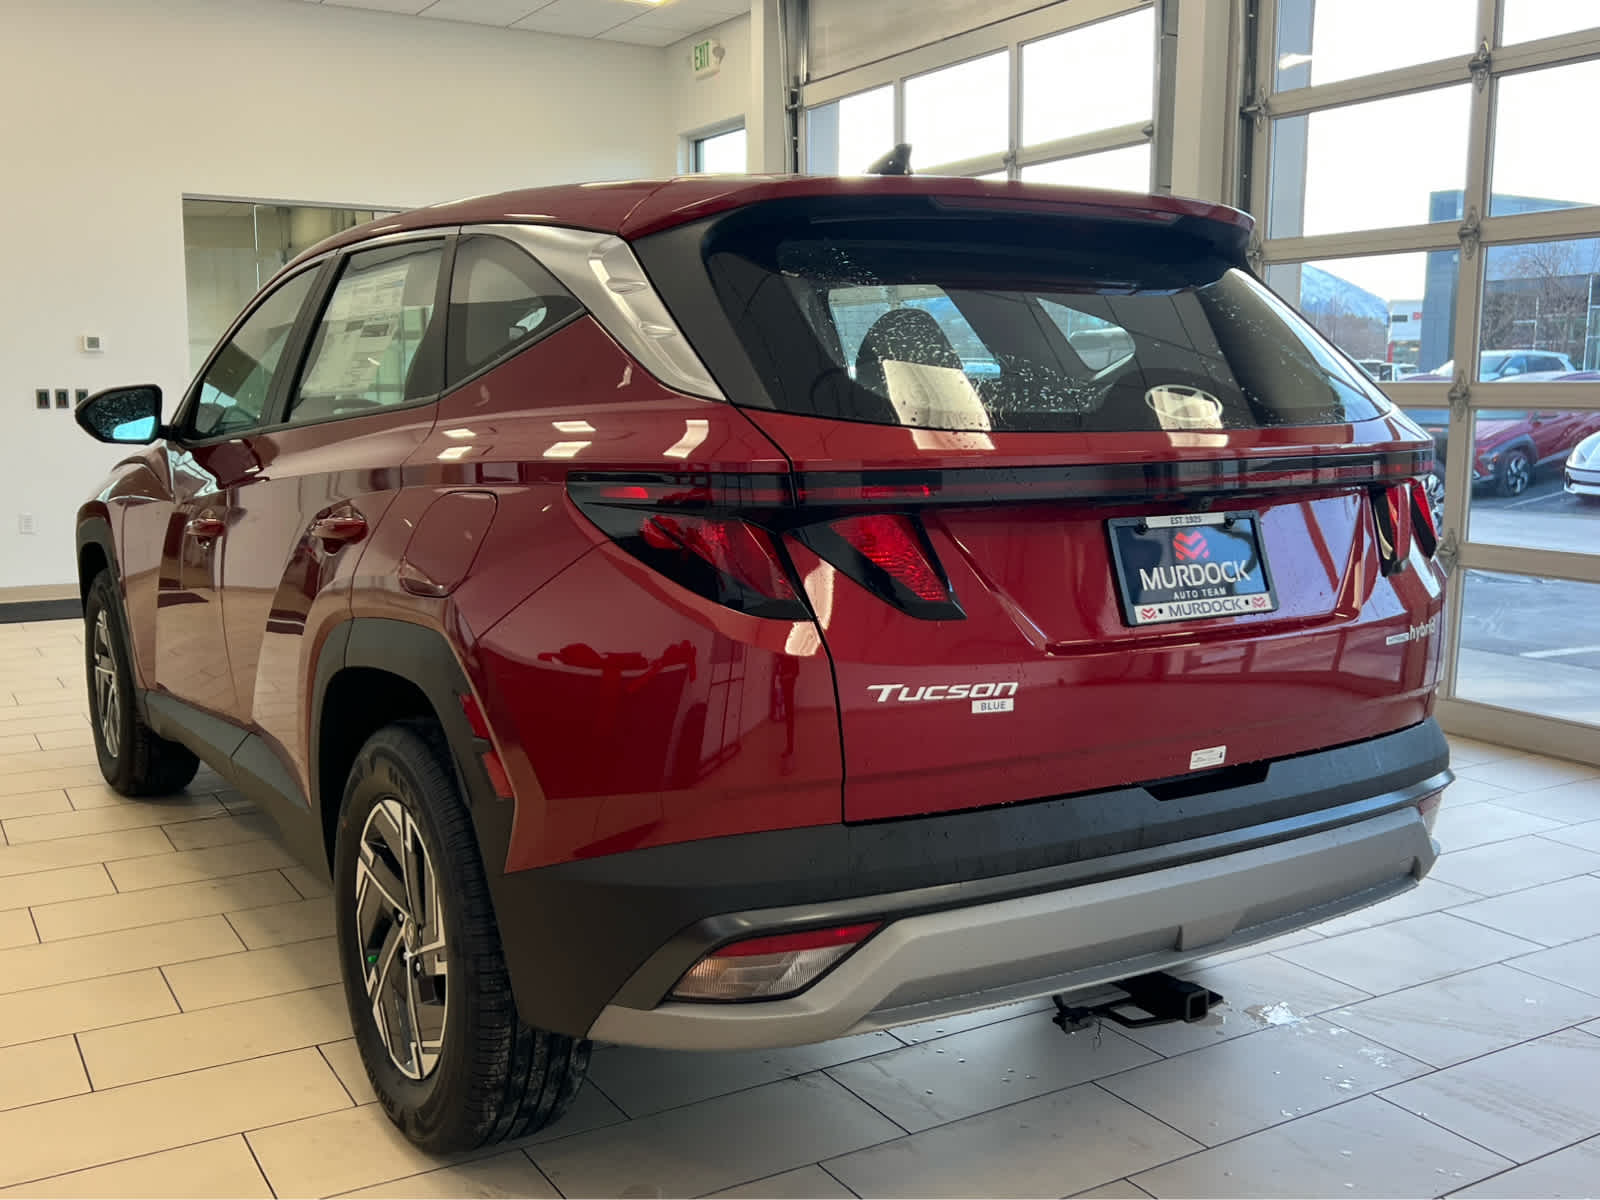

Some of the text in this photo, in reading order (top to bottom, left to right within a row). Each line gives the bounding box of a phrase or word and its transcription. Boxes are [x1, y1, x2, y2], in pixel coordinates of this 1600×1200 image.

[695, 42, 710, 70] EXIT
[1139, 560, 1251, 591] MURDOCK
[1173, 587, 1227, 600] AUTO TEAM
[1168, 599, 1242, 617] MURDOCK
[980, 701, 1006, 711] BLUE
